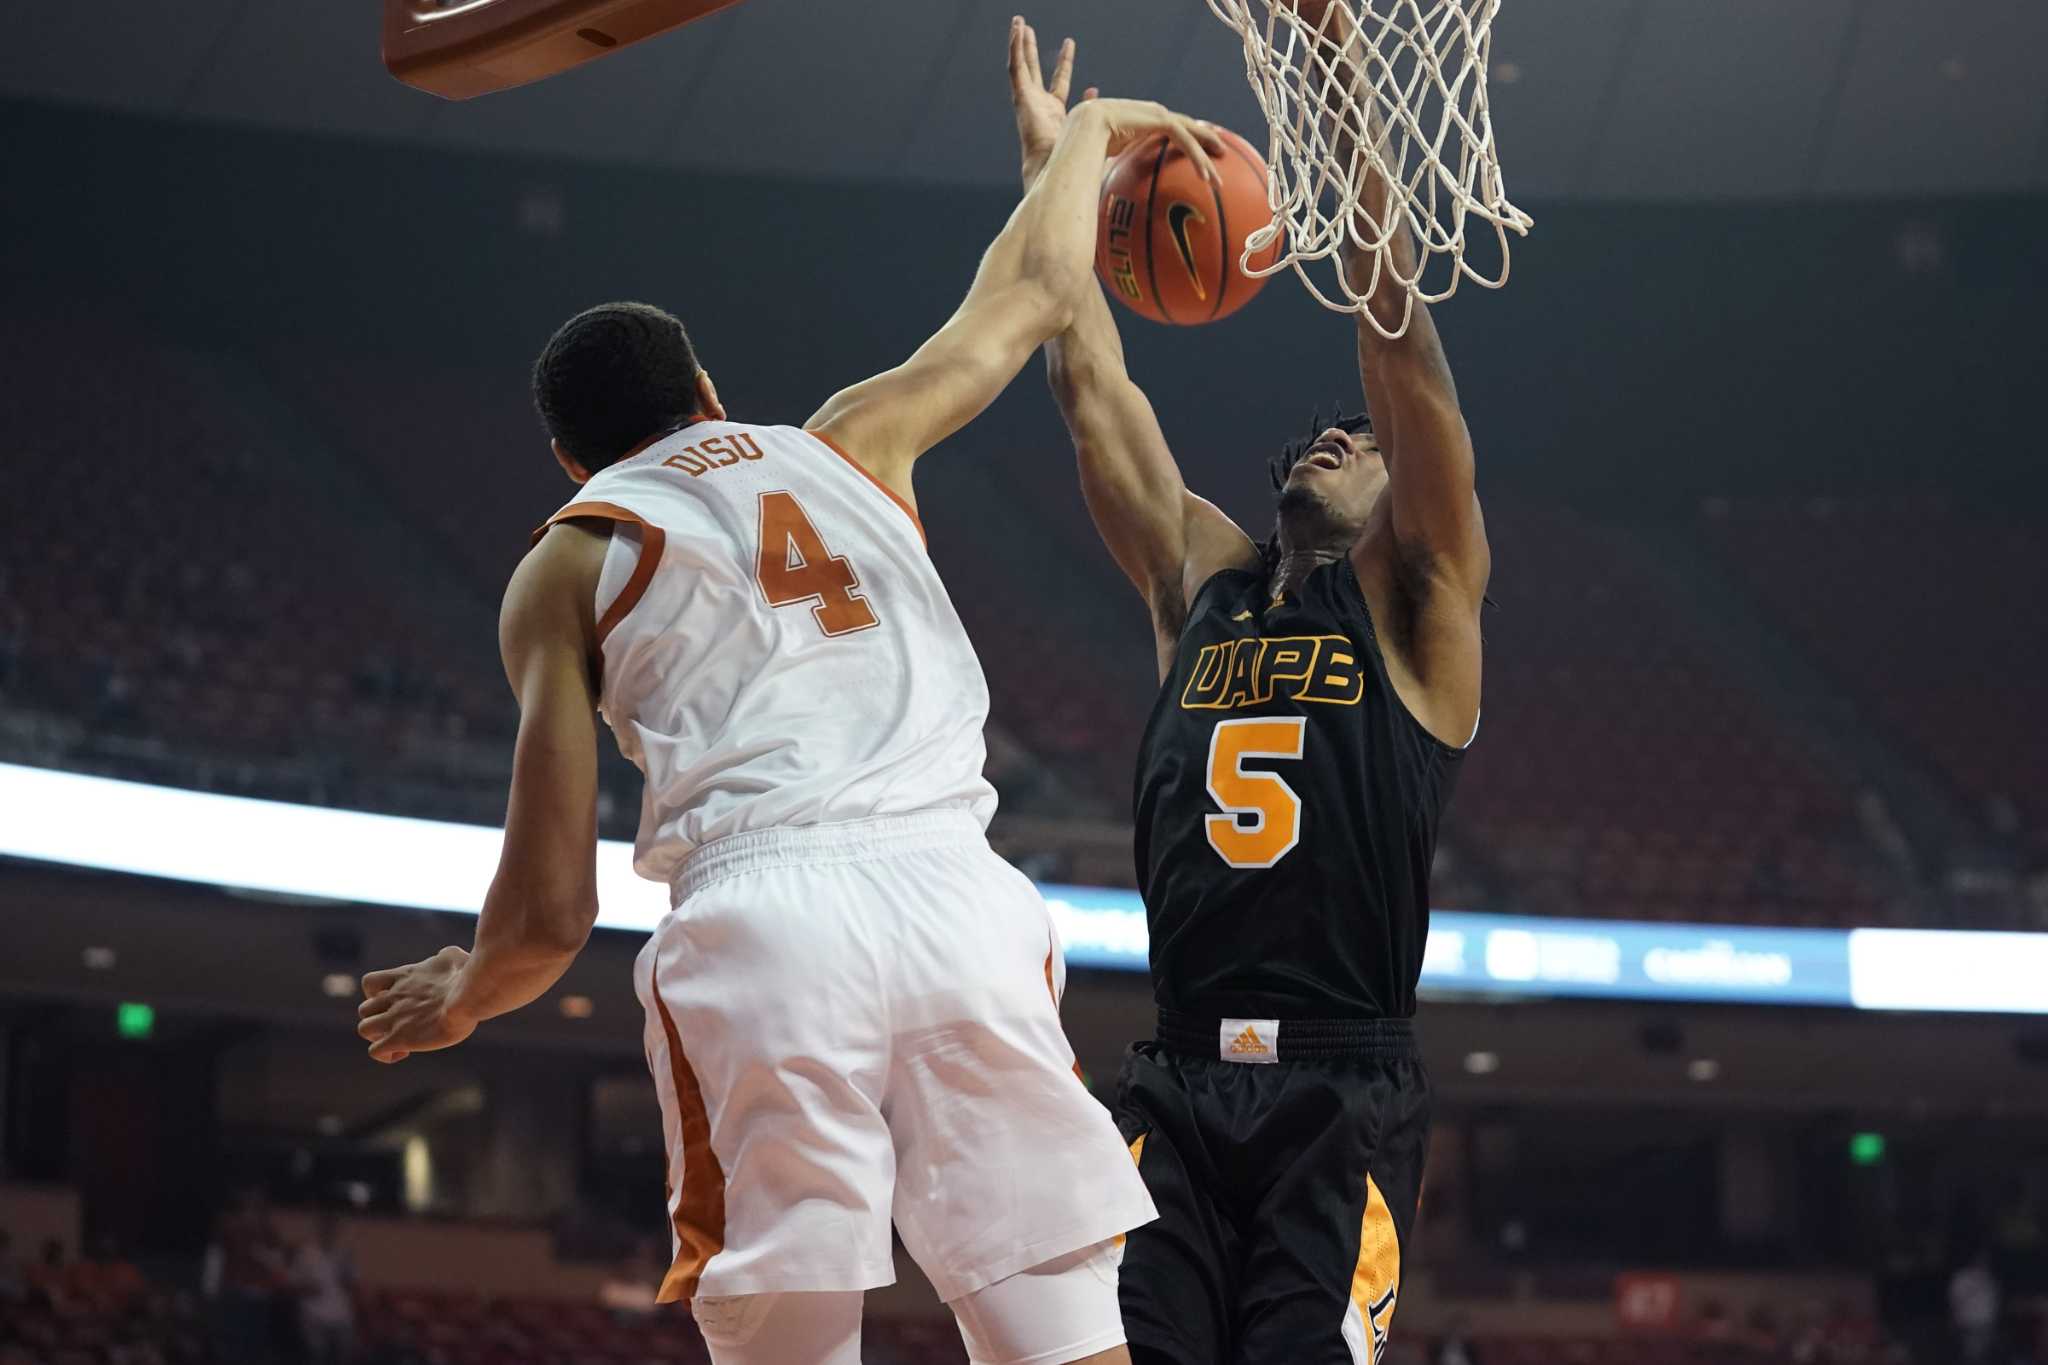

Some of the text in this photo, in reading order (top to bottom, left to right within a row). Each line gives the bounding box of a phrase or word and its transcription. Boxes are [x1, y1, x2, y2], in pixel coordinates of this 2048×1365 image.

[1107, 195, 1142, 300] ELITE
[661, 432, 764, 477] DISU
[755, 489, 881, 638] 4
[1181, 634, 1364, 709] UAPB
[1205, 716, 1307, 869] 5
